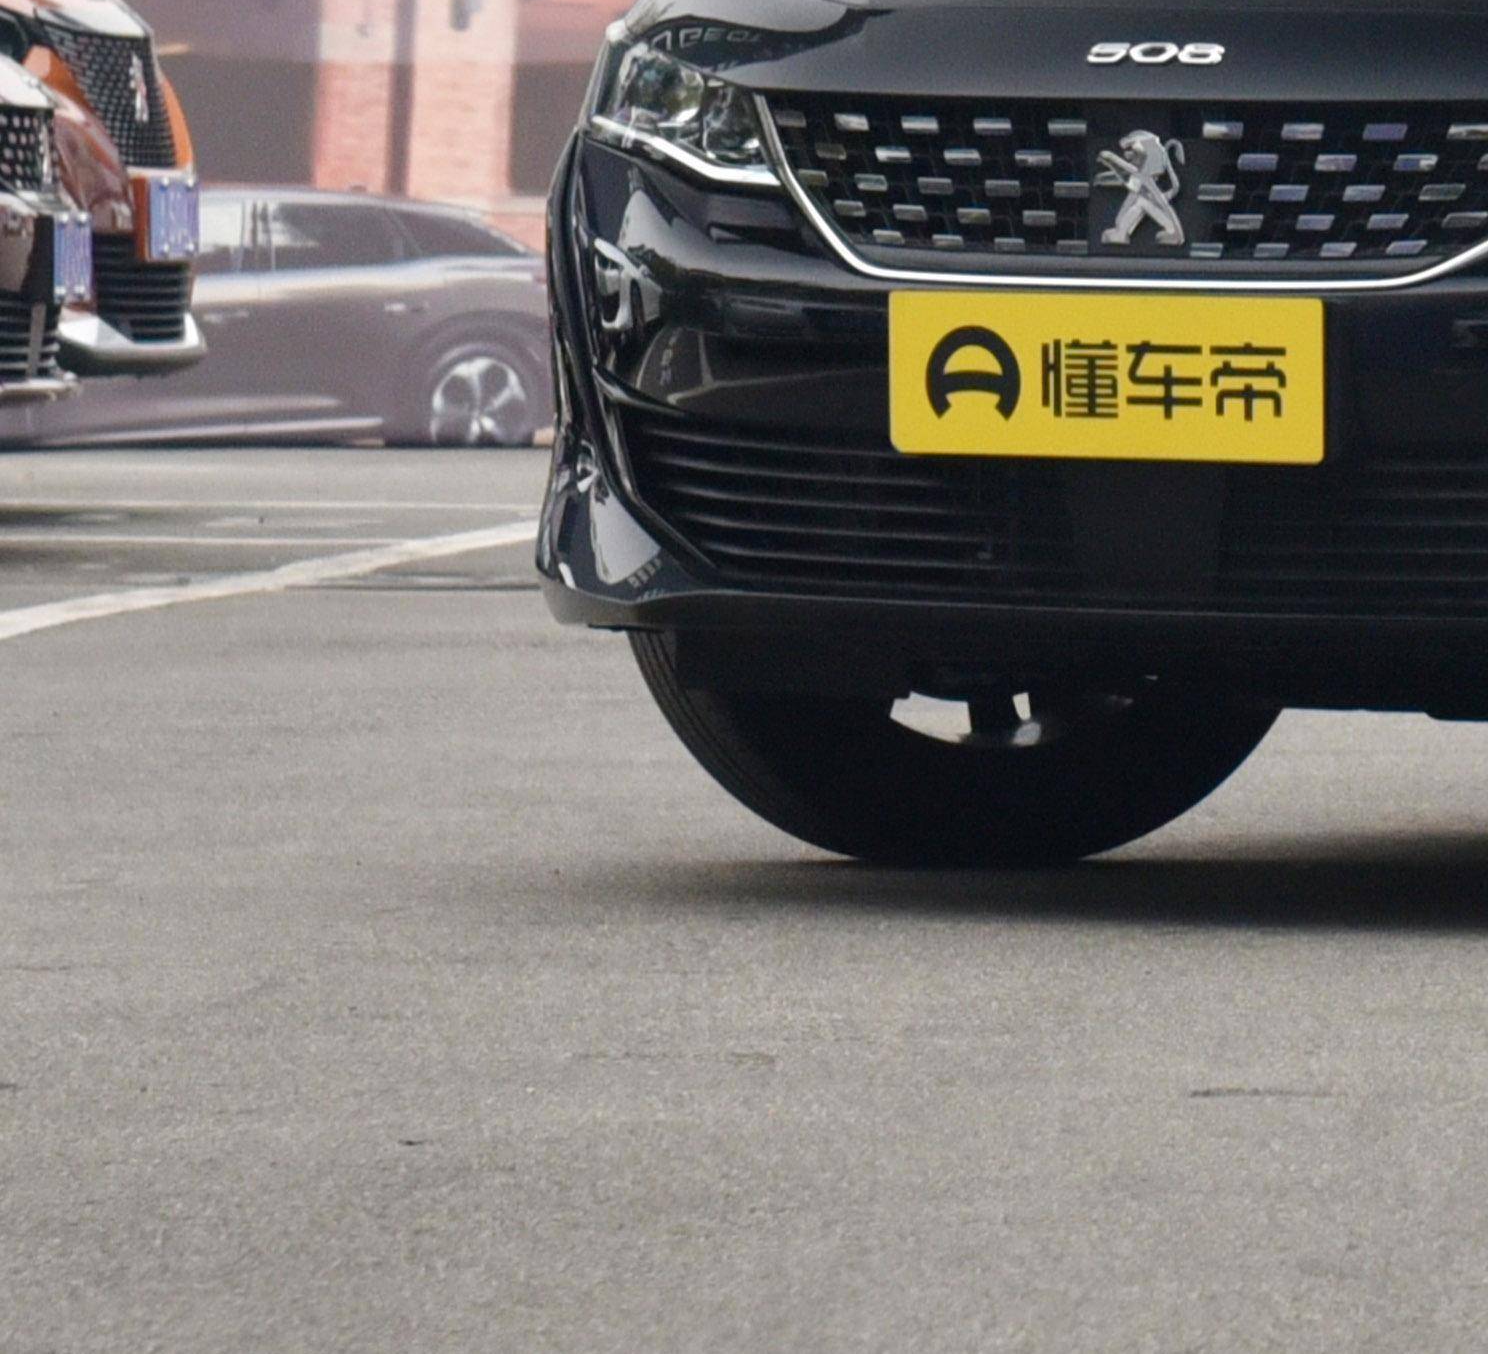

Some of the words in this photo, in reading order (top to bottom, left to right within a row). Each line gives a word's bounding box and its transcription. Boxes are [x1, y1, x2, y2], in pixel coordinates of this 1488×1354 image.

[1087, 42, 1225, 65] 508
[1041, 339, 1286, 422] 懂车帝
